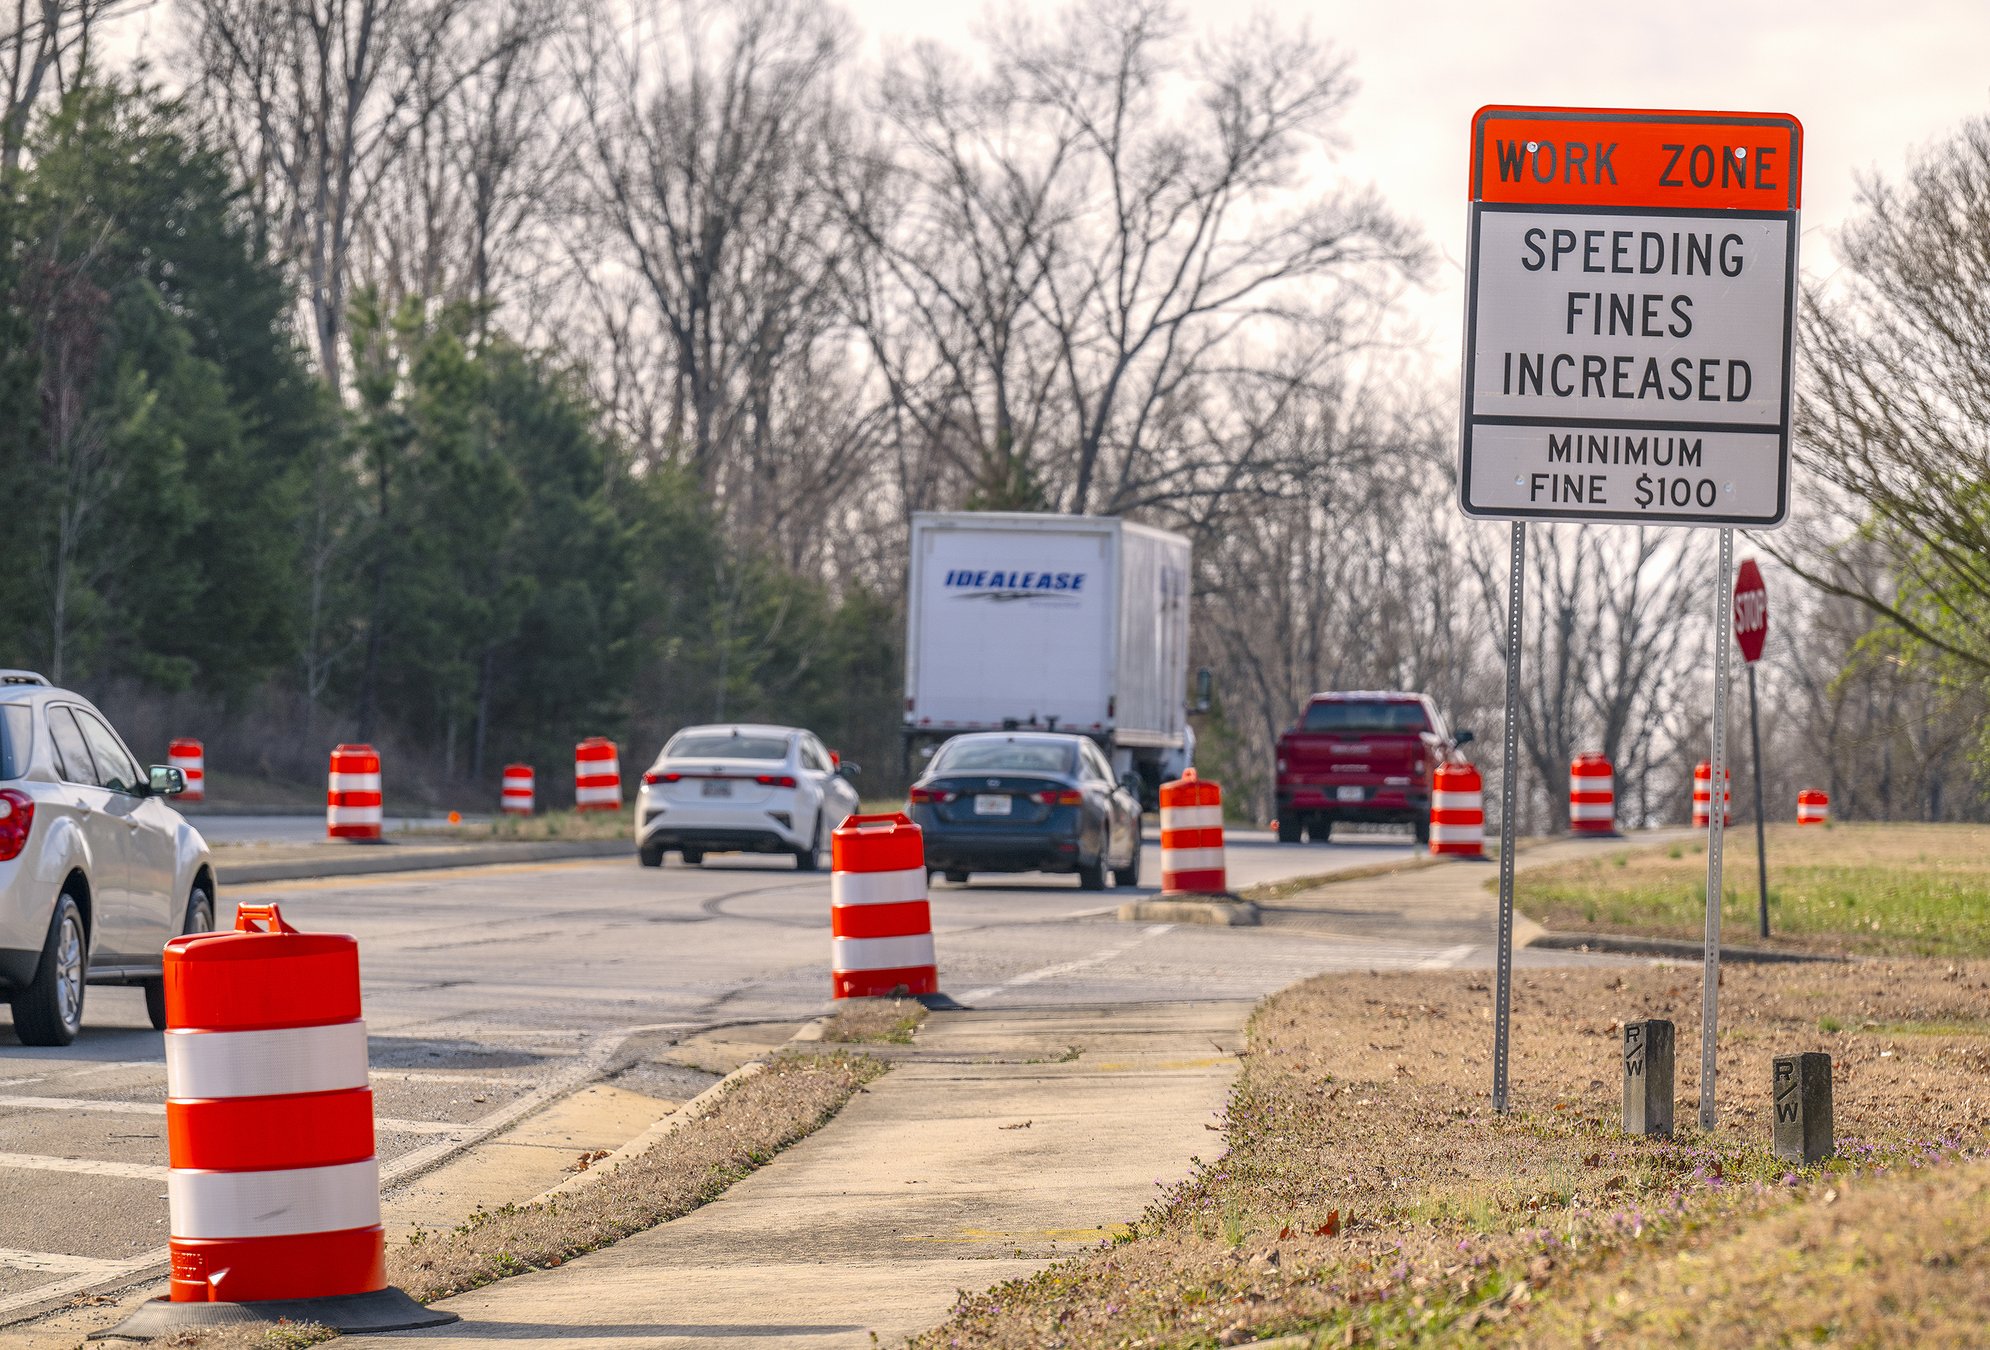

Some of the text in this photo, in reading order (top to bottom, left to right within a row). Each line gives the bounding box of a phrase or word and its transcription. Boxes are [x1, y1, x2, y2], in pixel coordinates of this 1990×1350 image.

[1496, 139, 1777, 190] WORK ZONE
[1521, 228, 1744, 277] SPEEDING
[1566, 292, 1694, 338] FINES
[1503, 352, 1752, 402] INCREASED
[1547, 434, 1703, 467] MINIMUM
[1530, 473, 1717, 509] FINE $100
[945, 569, 1087, 591] IDEALEASE
[1735, 590, 1768, 634] STOP
